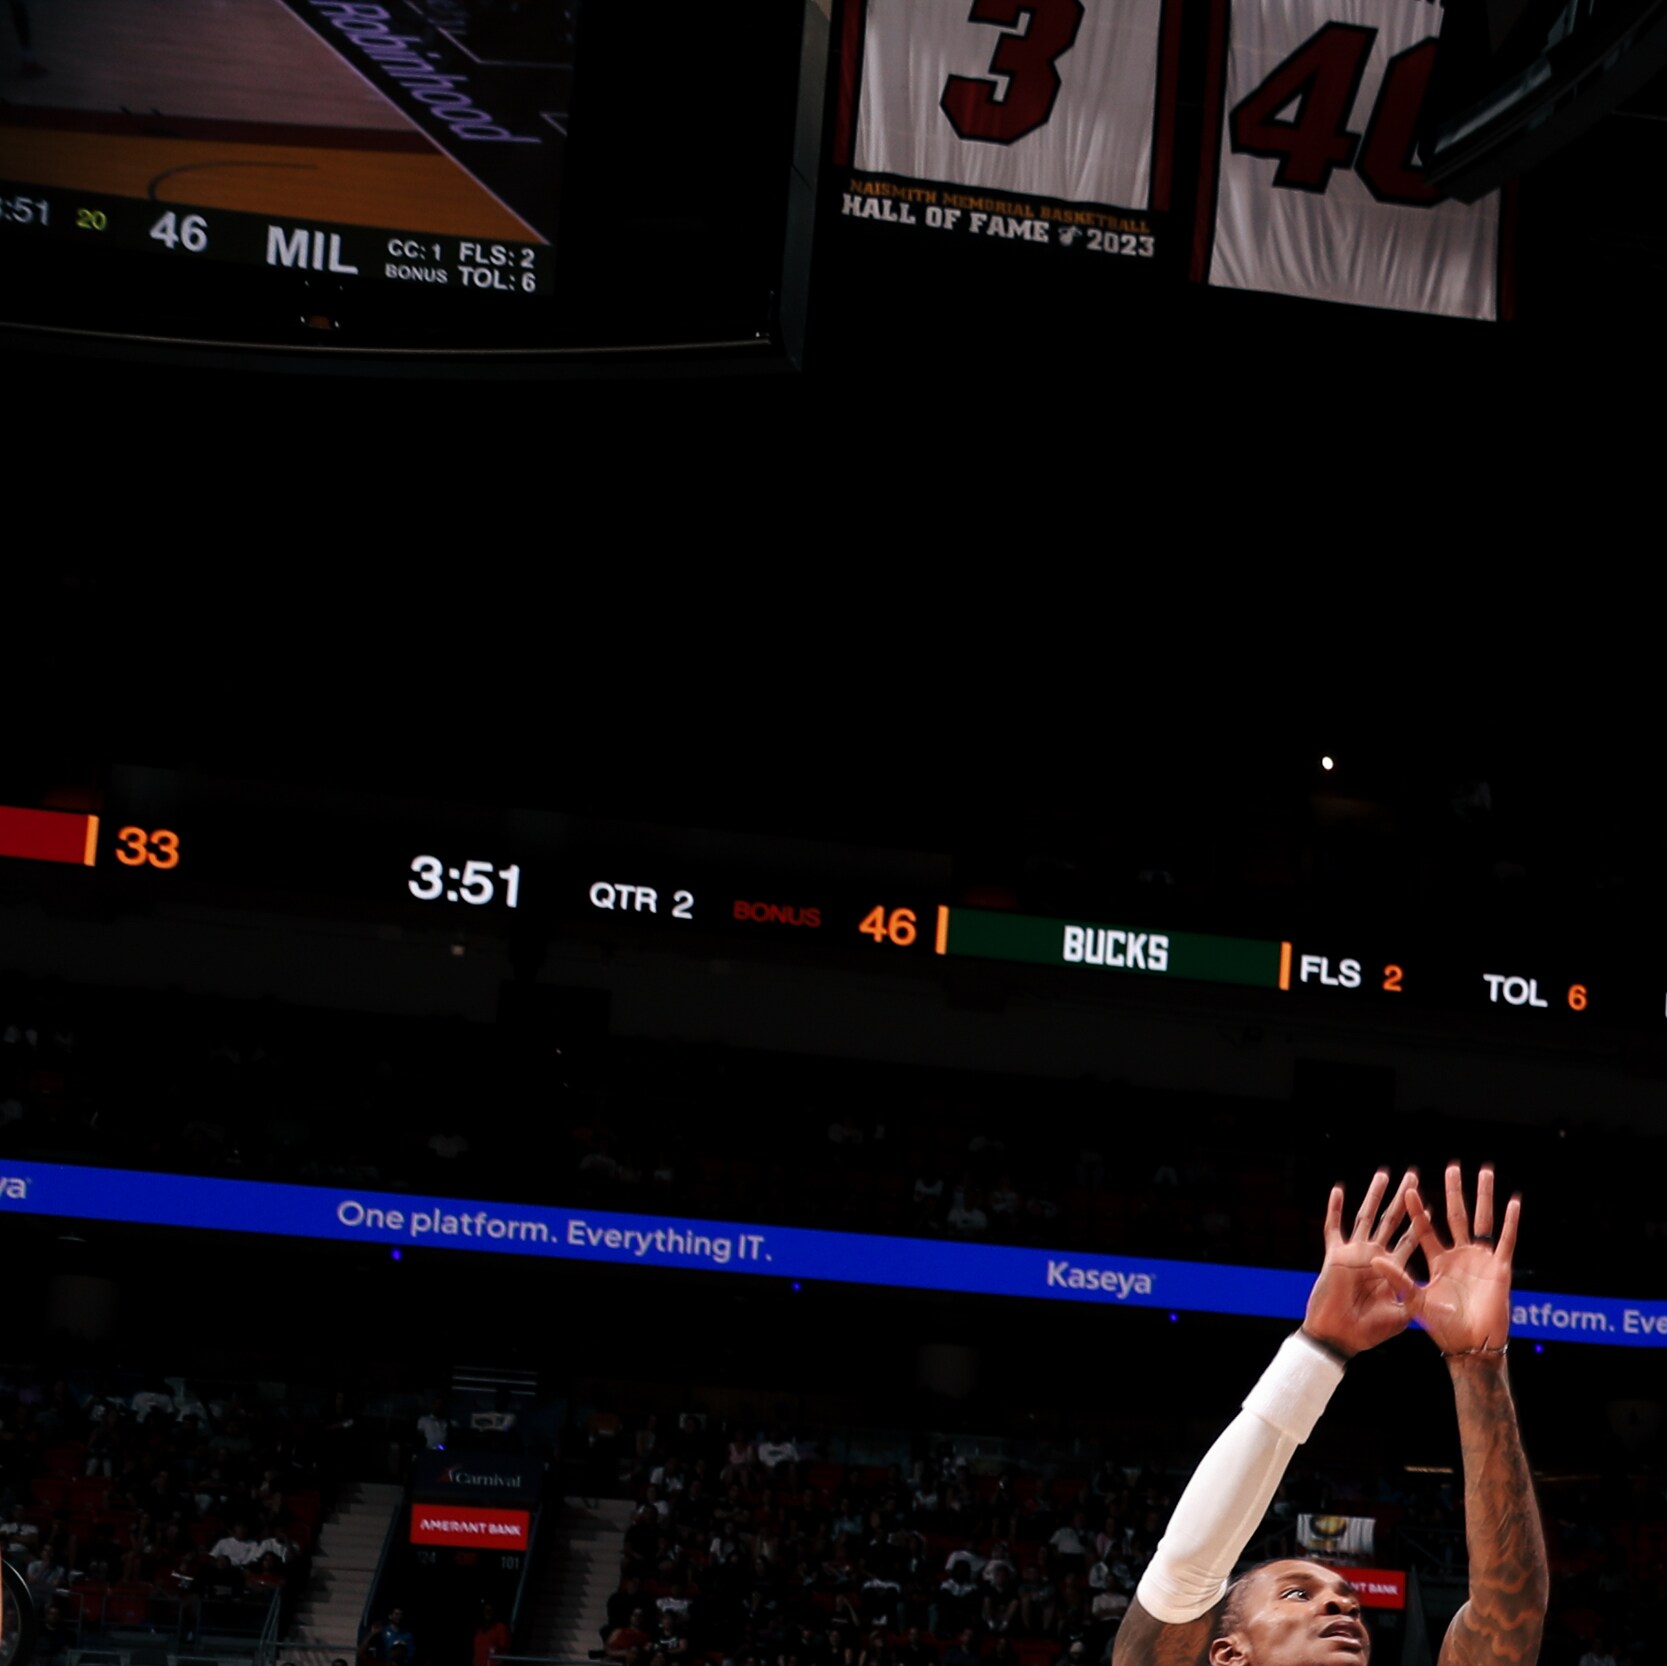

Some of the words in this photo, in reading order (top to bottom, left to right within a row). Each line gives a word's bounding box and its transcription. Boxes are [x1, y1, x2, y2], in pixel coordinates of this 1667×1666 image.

[942, 0, 1084, 145] 3
[75, 208, 108, 232] 20
[841, 192, 917, 225] HALL
[924, 206, 962, 230] OF
[968, 211, 1050, 244] FAME
[1086, 227, 1156, 258] 2023
[849, 178, 937, 204] NAISMITH
[942, 191, 1034, 219] MEMORIAL
[1040, 205, 1151, 234] BASKETBALL
[149, 210, 209, 253] 46
[266, 224, 360, 275] MIL
[388, 238, 426, 261] CC:
[431, 243, 442, 261] 1
[459, 241, 515, 268] FLS:
[520, 248, 536, 270] 2
[384, 262, 449, 285] BONUS
[457, 265, 516, 292] TOL:
[520, 272, 537, 294] 6
[115, 825, 180, 870] 33
[407, 854, 521, 909] 3:51
[588, 881, 657, 914] QTR
[671, 889, 695, 920] 2
[732, 900, 823, 928] BONUS
[858, 903, 918, 948] 46
[1062, 924, 1169, 972] BUCKS
[1299, 953, 1362, 989] FLS
[1381, 963, 1405, 993] 2
[1482, 973, 1549, 1008] TOL
[1566, 983, 1589, 1012] 6
[336, 1200, 404, 1232] One
[410, 1207, 558, 1244] platform.
[566, 1219, 731, 1265] Everything
[737, 1234, 773, 1262] IT.
[1046, 1260, 1154, 1301] Kaseya
[420, 1518, 487, 1534] AMERANT
[488, 1522, 521, 1537] BANK
[1367, 1582, 1399, 1596] BANK
